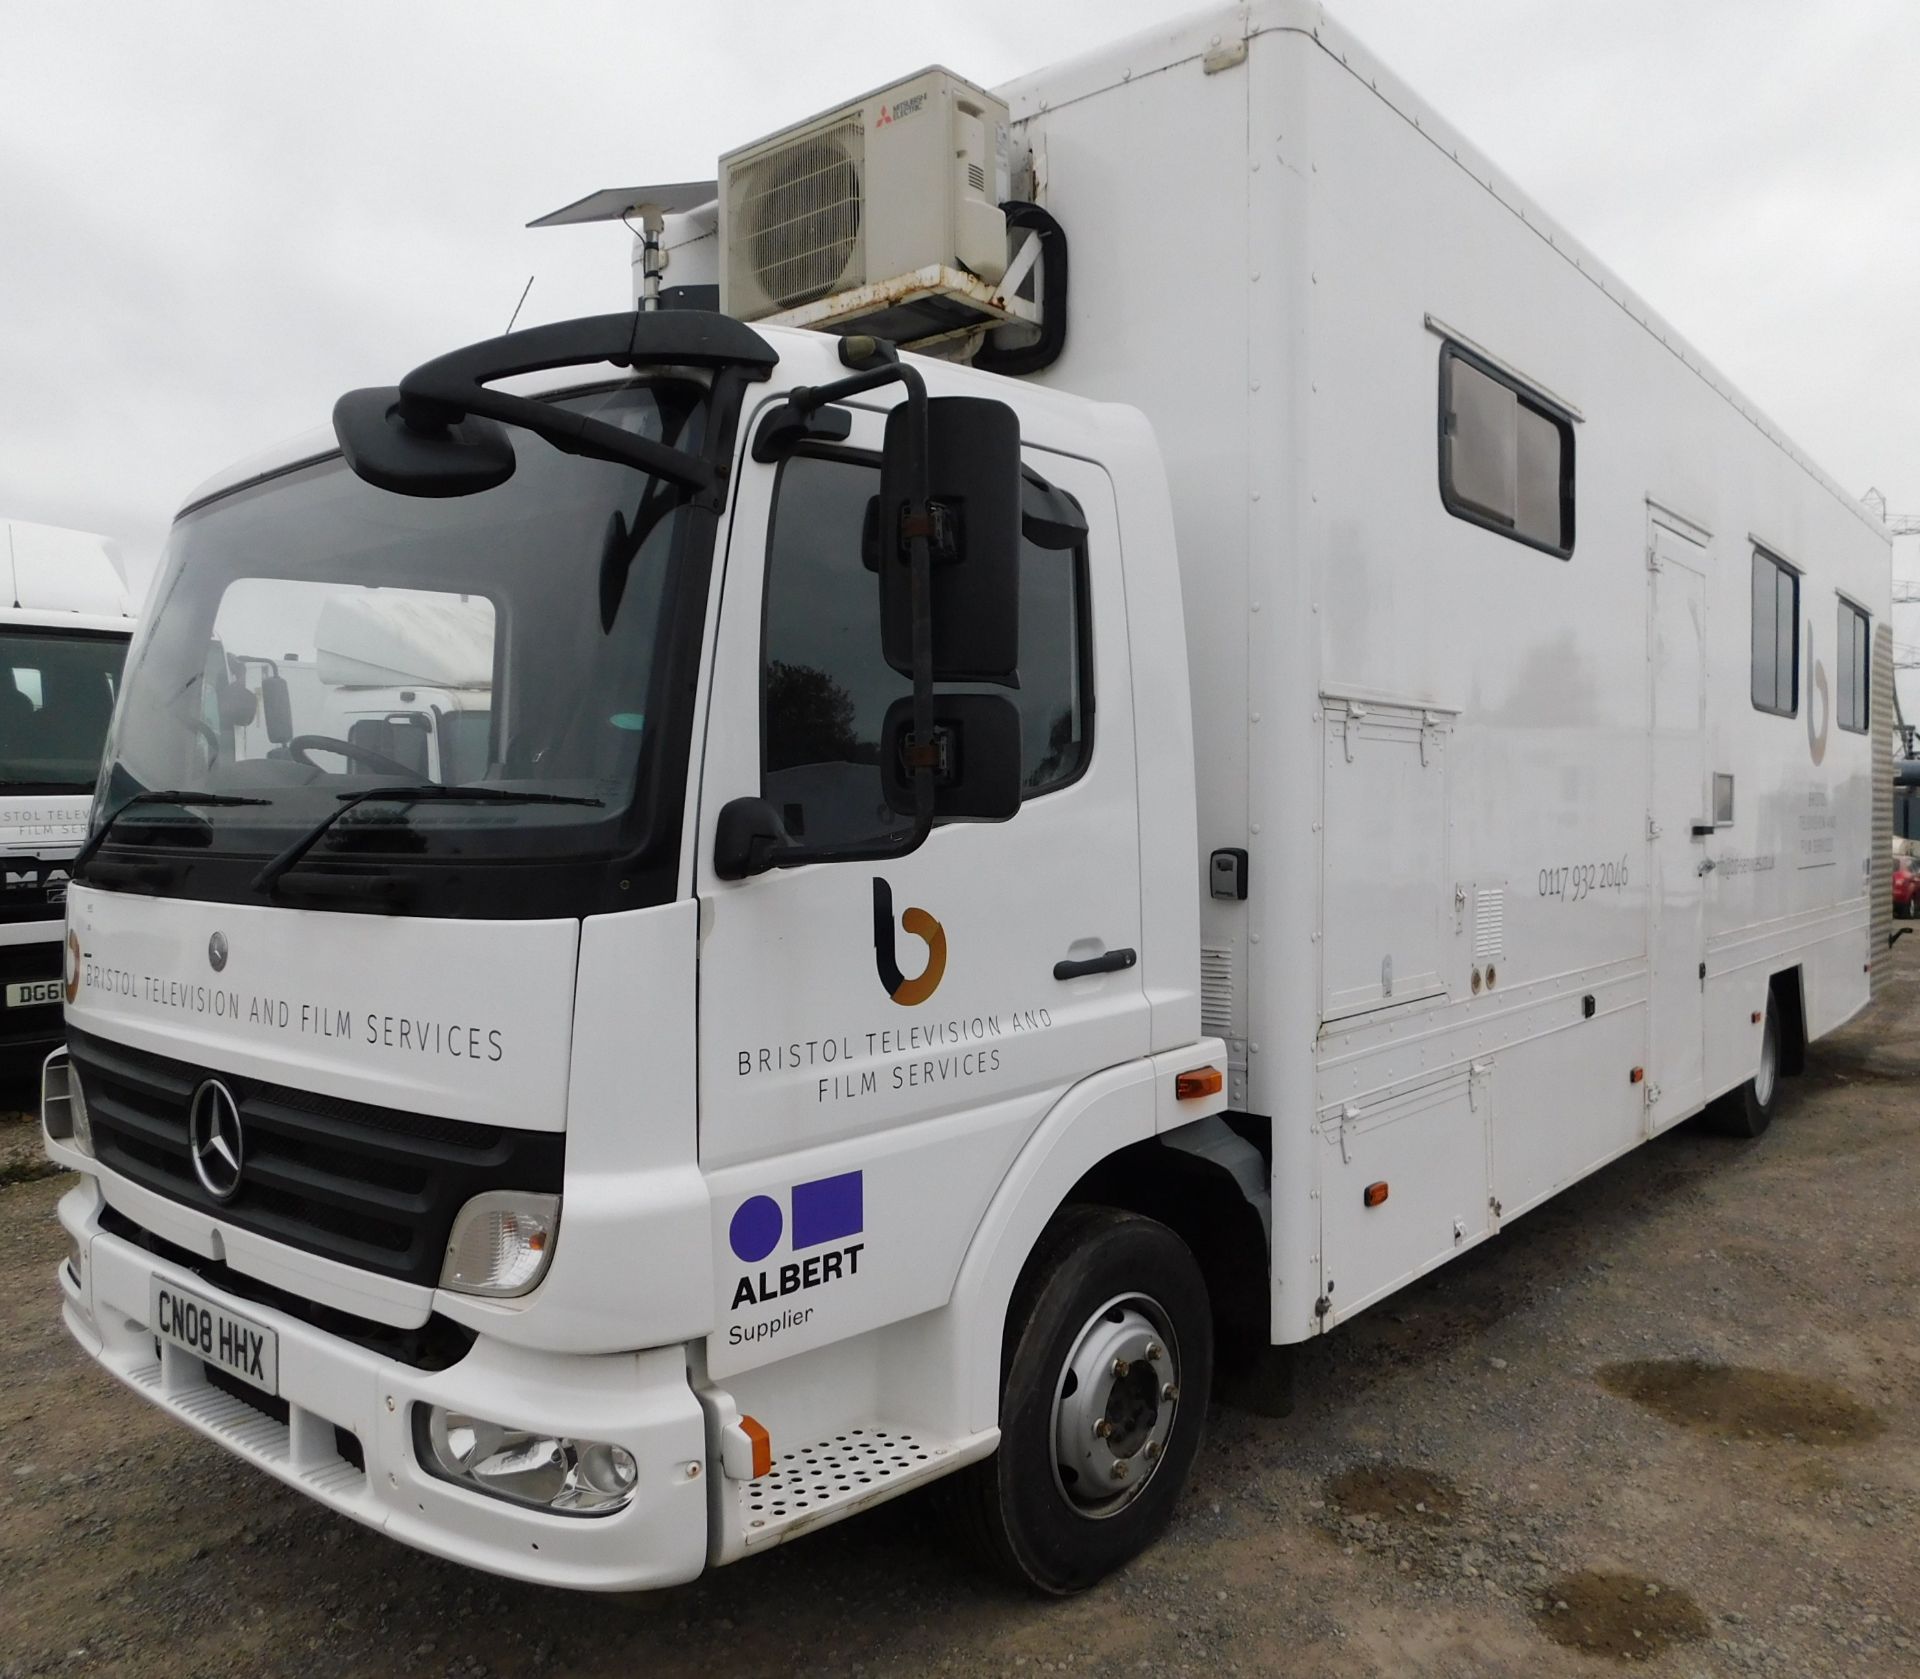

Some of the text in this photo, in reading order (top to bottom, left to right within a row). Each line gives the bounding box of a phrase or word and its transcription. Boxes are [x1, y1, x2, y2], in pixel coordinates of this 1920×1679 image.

[1538, 853, 1628, 902] 0117 932 2046
[86, 964, 138, 998] BRISTOL
[145, 976, 239, 1019] TELEVISION
[250, 996, 289, 1028] AND
[302, 1004, 351, 1040] FILM
[366, 1013, 503, 1062] SERVICES
[738, 1007, 1053, 1076] BRISTOL TELEVISION AND
[818, 1049, 1001, 1102] FILM SERVICES
[730, 1242, 865, 1311] ALBERT
[158, 1289, 264, 1381] CN08 HHX
[728, 1307, 814, 1346] Supplier
